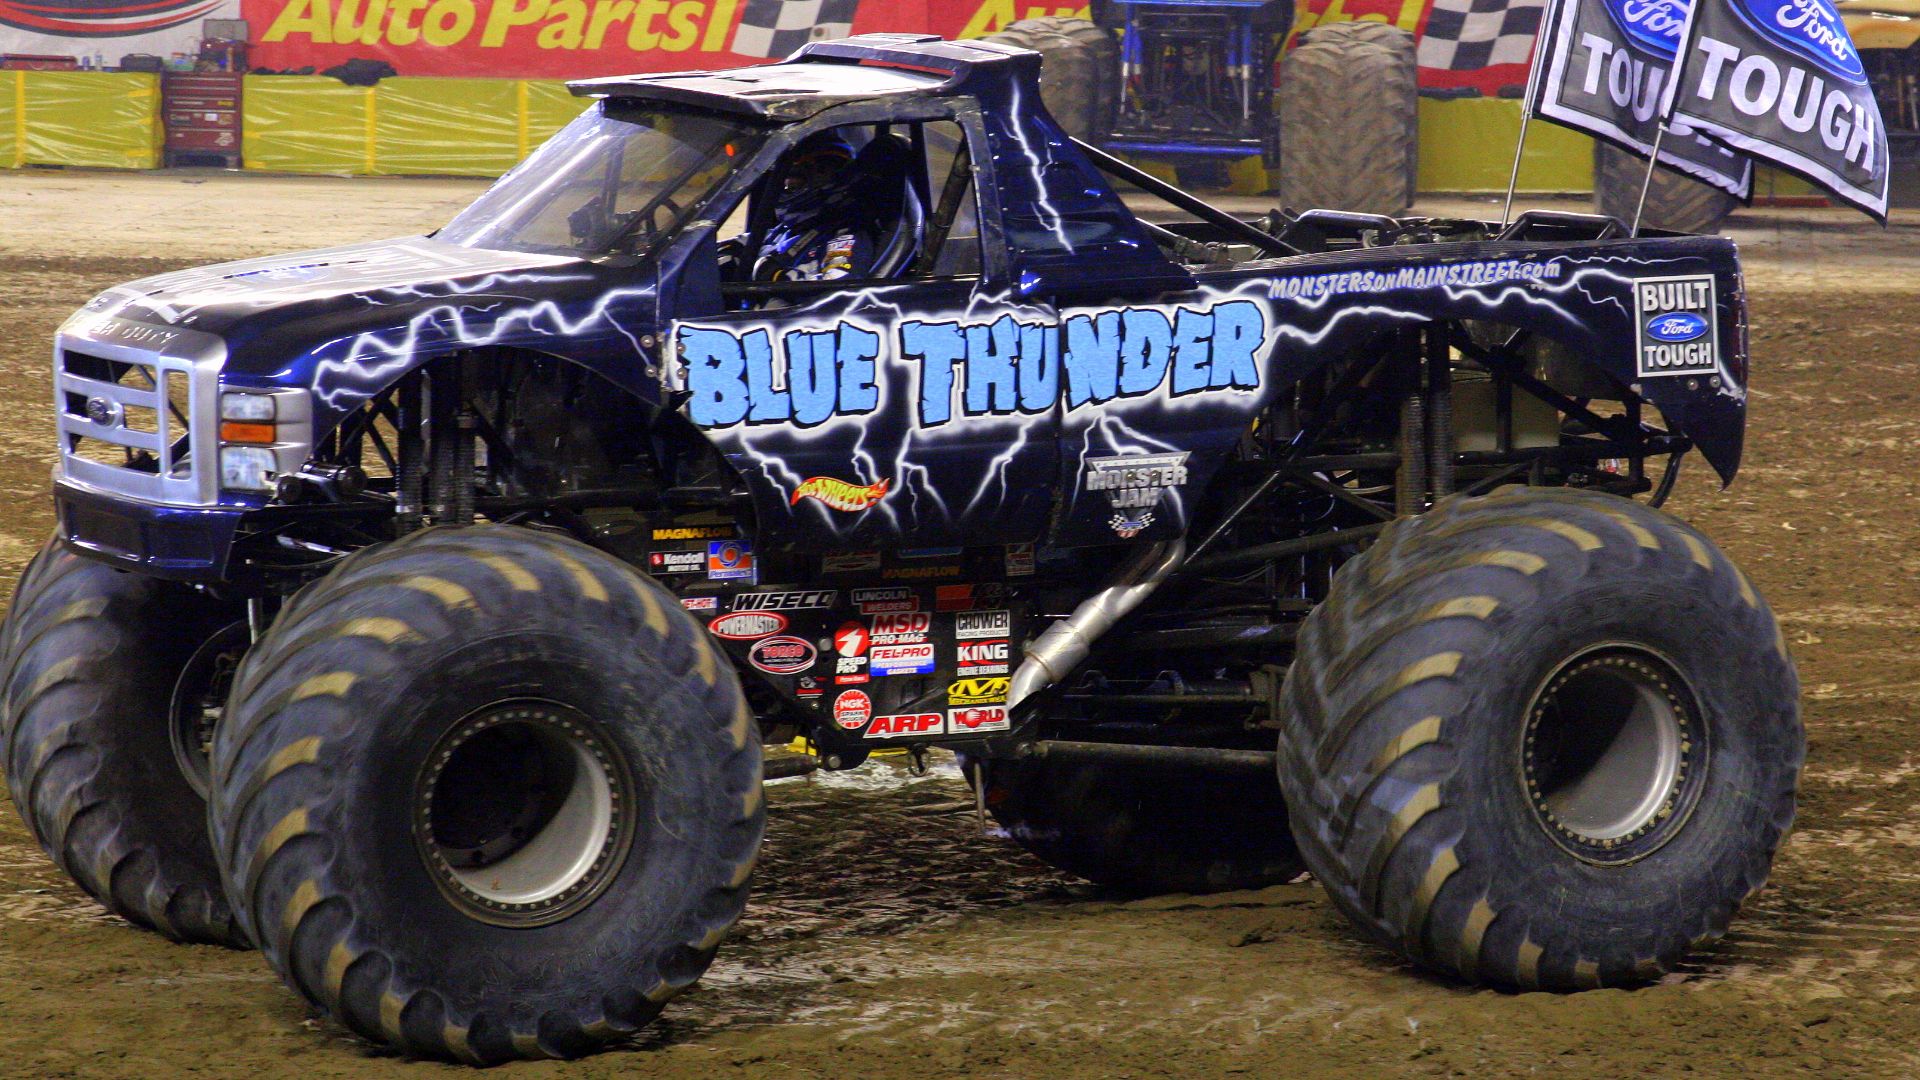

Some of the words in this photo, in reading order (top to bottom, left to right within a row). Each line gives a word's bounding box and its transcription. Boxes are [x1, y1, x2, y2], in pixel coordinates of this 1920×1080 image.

[262, 0, 476, 46] Auto
[1776, 0, 1848, 61] Ford
[1697, 36, 1875, 173] TOUGH
[1268, 261, 1561, 299] MONSTERSonMAINSTREET.com
[1642, 282, 1710, 311] BUILT
[1661, 319, 1693, 335] Ford
[679, 321, 880, 428] BLUE
[900, 299, 1265, 428] THUNDER
[1644, 343, 1712, 367] TOUGH
[1111, 487, 1159, 508] JAM
[664, 552, 705, 565] Kendall
[734, 590, 836, 611] WISECO
[855, 590, 908, 601] LINCOLN
[866, 602, 913, 612] WELDERS
[717, 614, 780, 636] POWERMASTER
[872, 613, 929, 635] MSD
[958, 612, 1008, 630] CROWER
[762, 645, 804, 658] TORCO
[837, 656, 868, 666] SPEED
[871, 646, 931, 660] FEL-PRO
[957, 643, 1009, 662] KING
[836, 665, 858, 674] PRO
[839, 699, 865, 710] NGK
[868, 714, 941, 734] ARP
[954, 708, 1005, 726] WORLD
